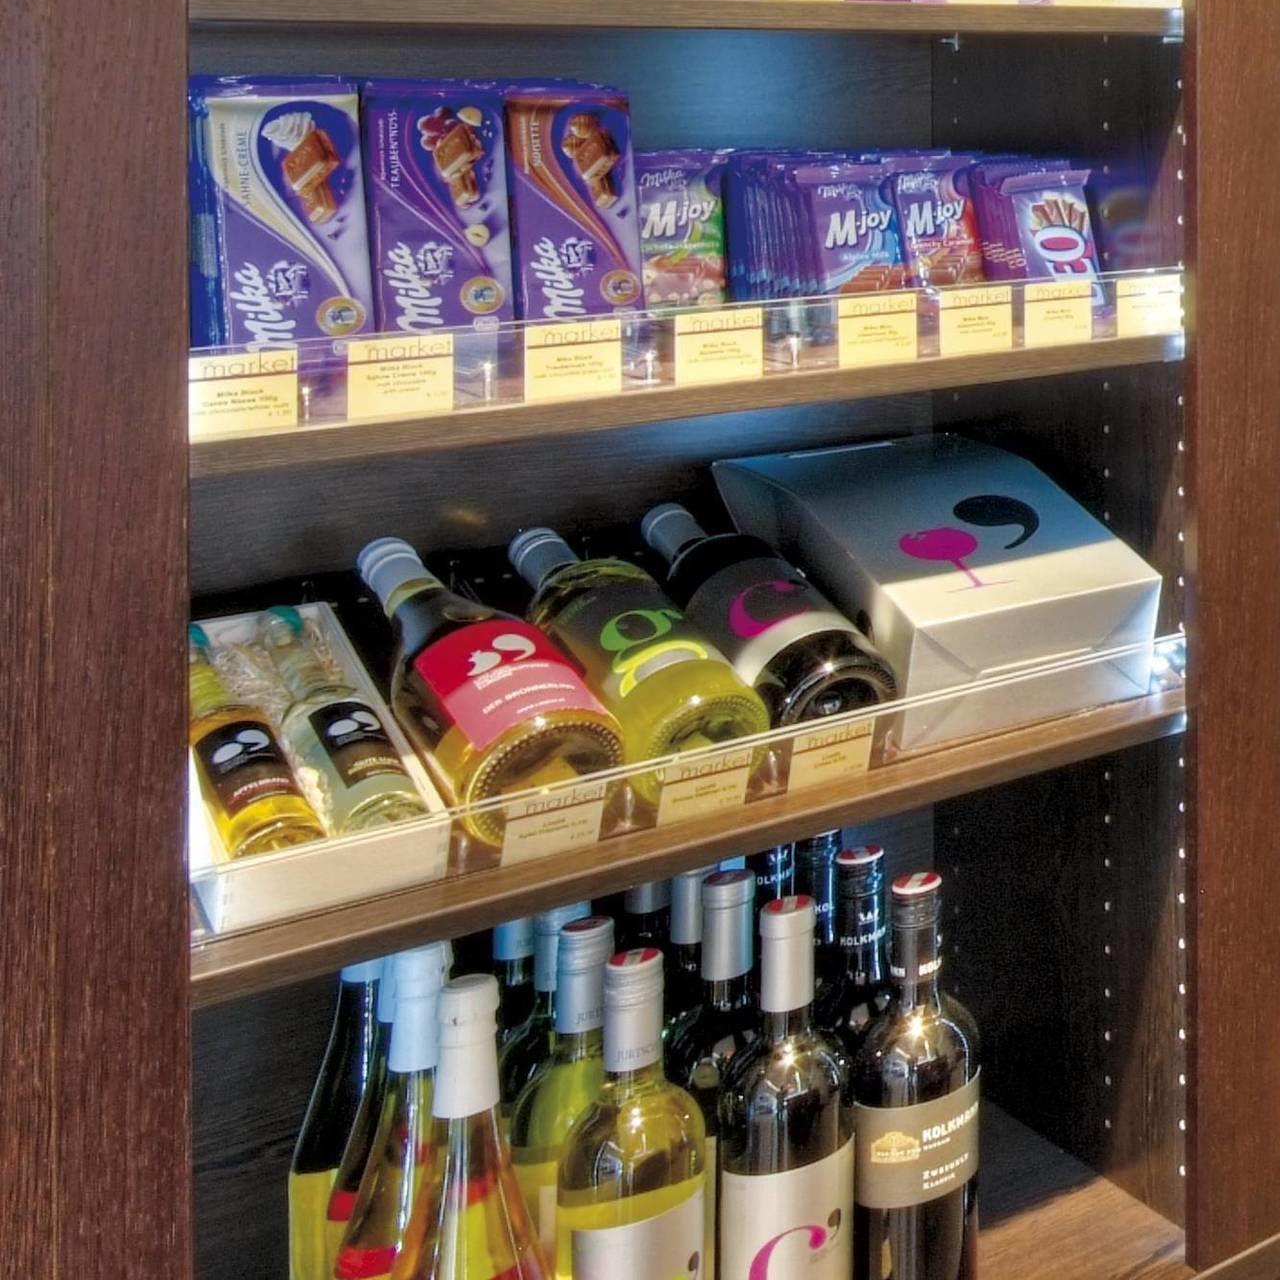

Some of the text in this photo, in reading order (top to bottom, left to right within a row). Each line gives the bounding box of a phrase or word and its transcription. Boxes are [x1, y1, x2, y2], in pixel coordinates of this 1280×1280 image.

[383, 241, 444, 332] Milka
[530, 237, 587, 320] Milka
[230, 261, 297, 352] Milka
[544, 323, 620, 345] market
[692, 311, 762, 332] market
[367, 336, 453, 361] market
[203, 352, 295, 377] market
